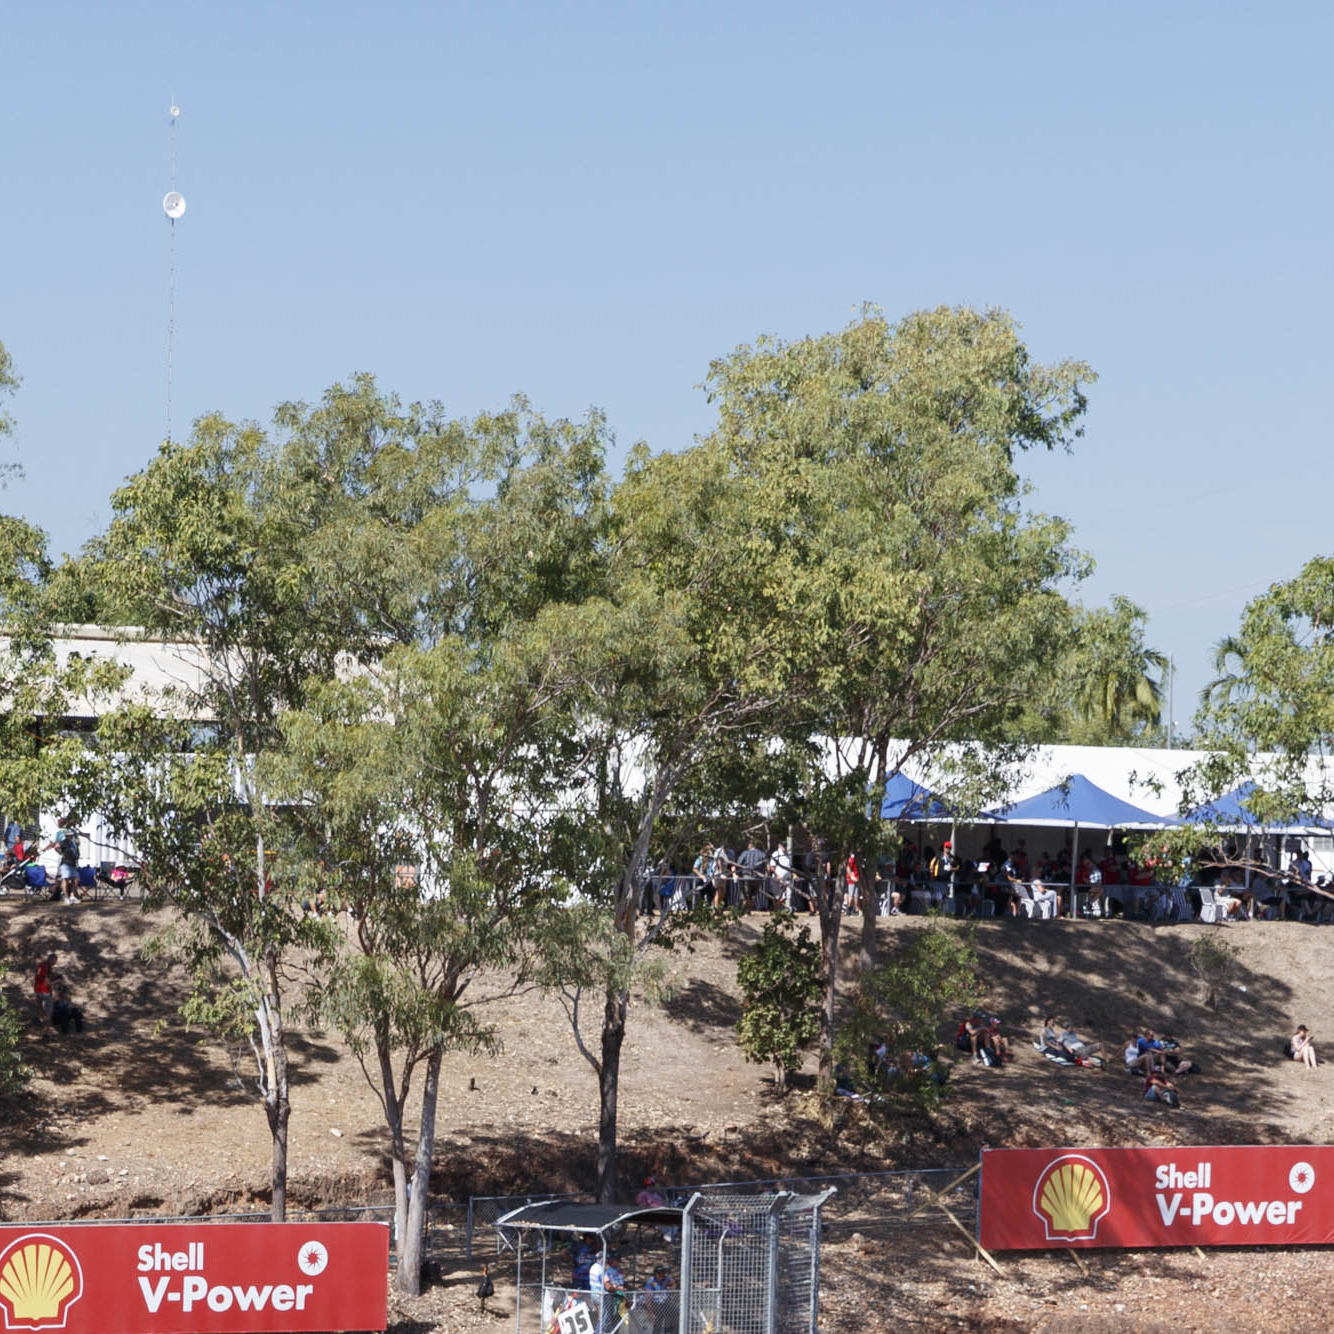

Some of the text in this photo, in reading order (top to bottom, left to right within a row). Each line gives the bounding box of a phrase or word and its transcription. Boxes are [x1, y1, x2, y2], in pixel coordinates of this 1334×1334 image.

[1155, 1162, 1211, 1190] Shell
[1155, 1193, 1303, 1226] V-Power
[137, 1242, 204, 1272] Shell
[137, 1276, 314, 1313] V-Power
